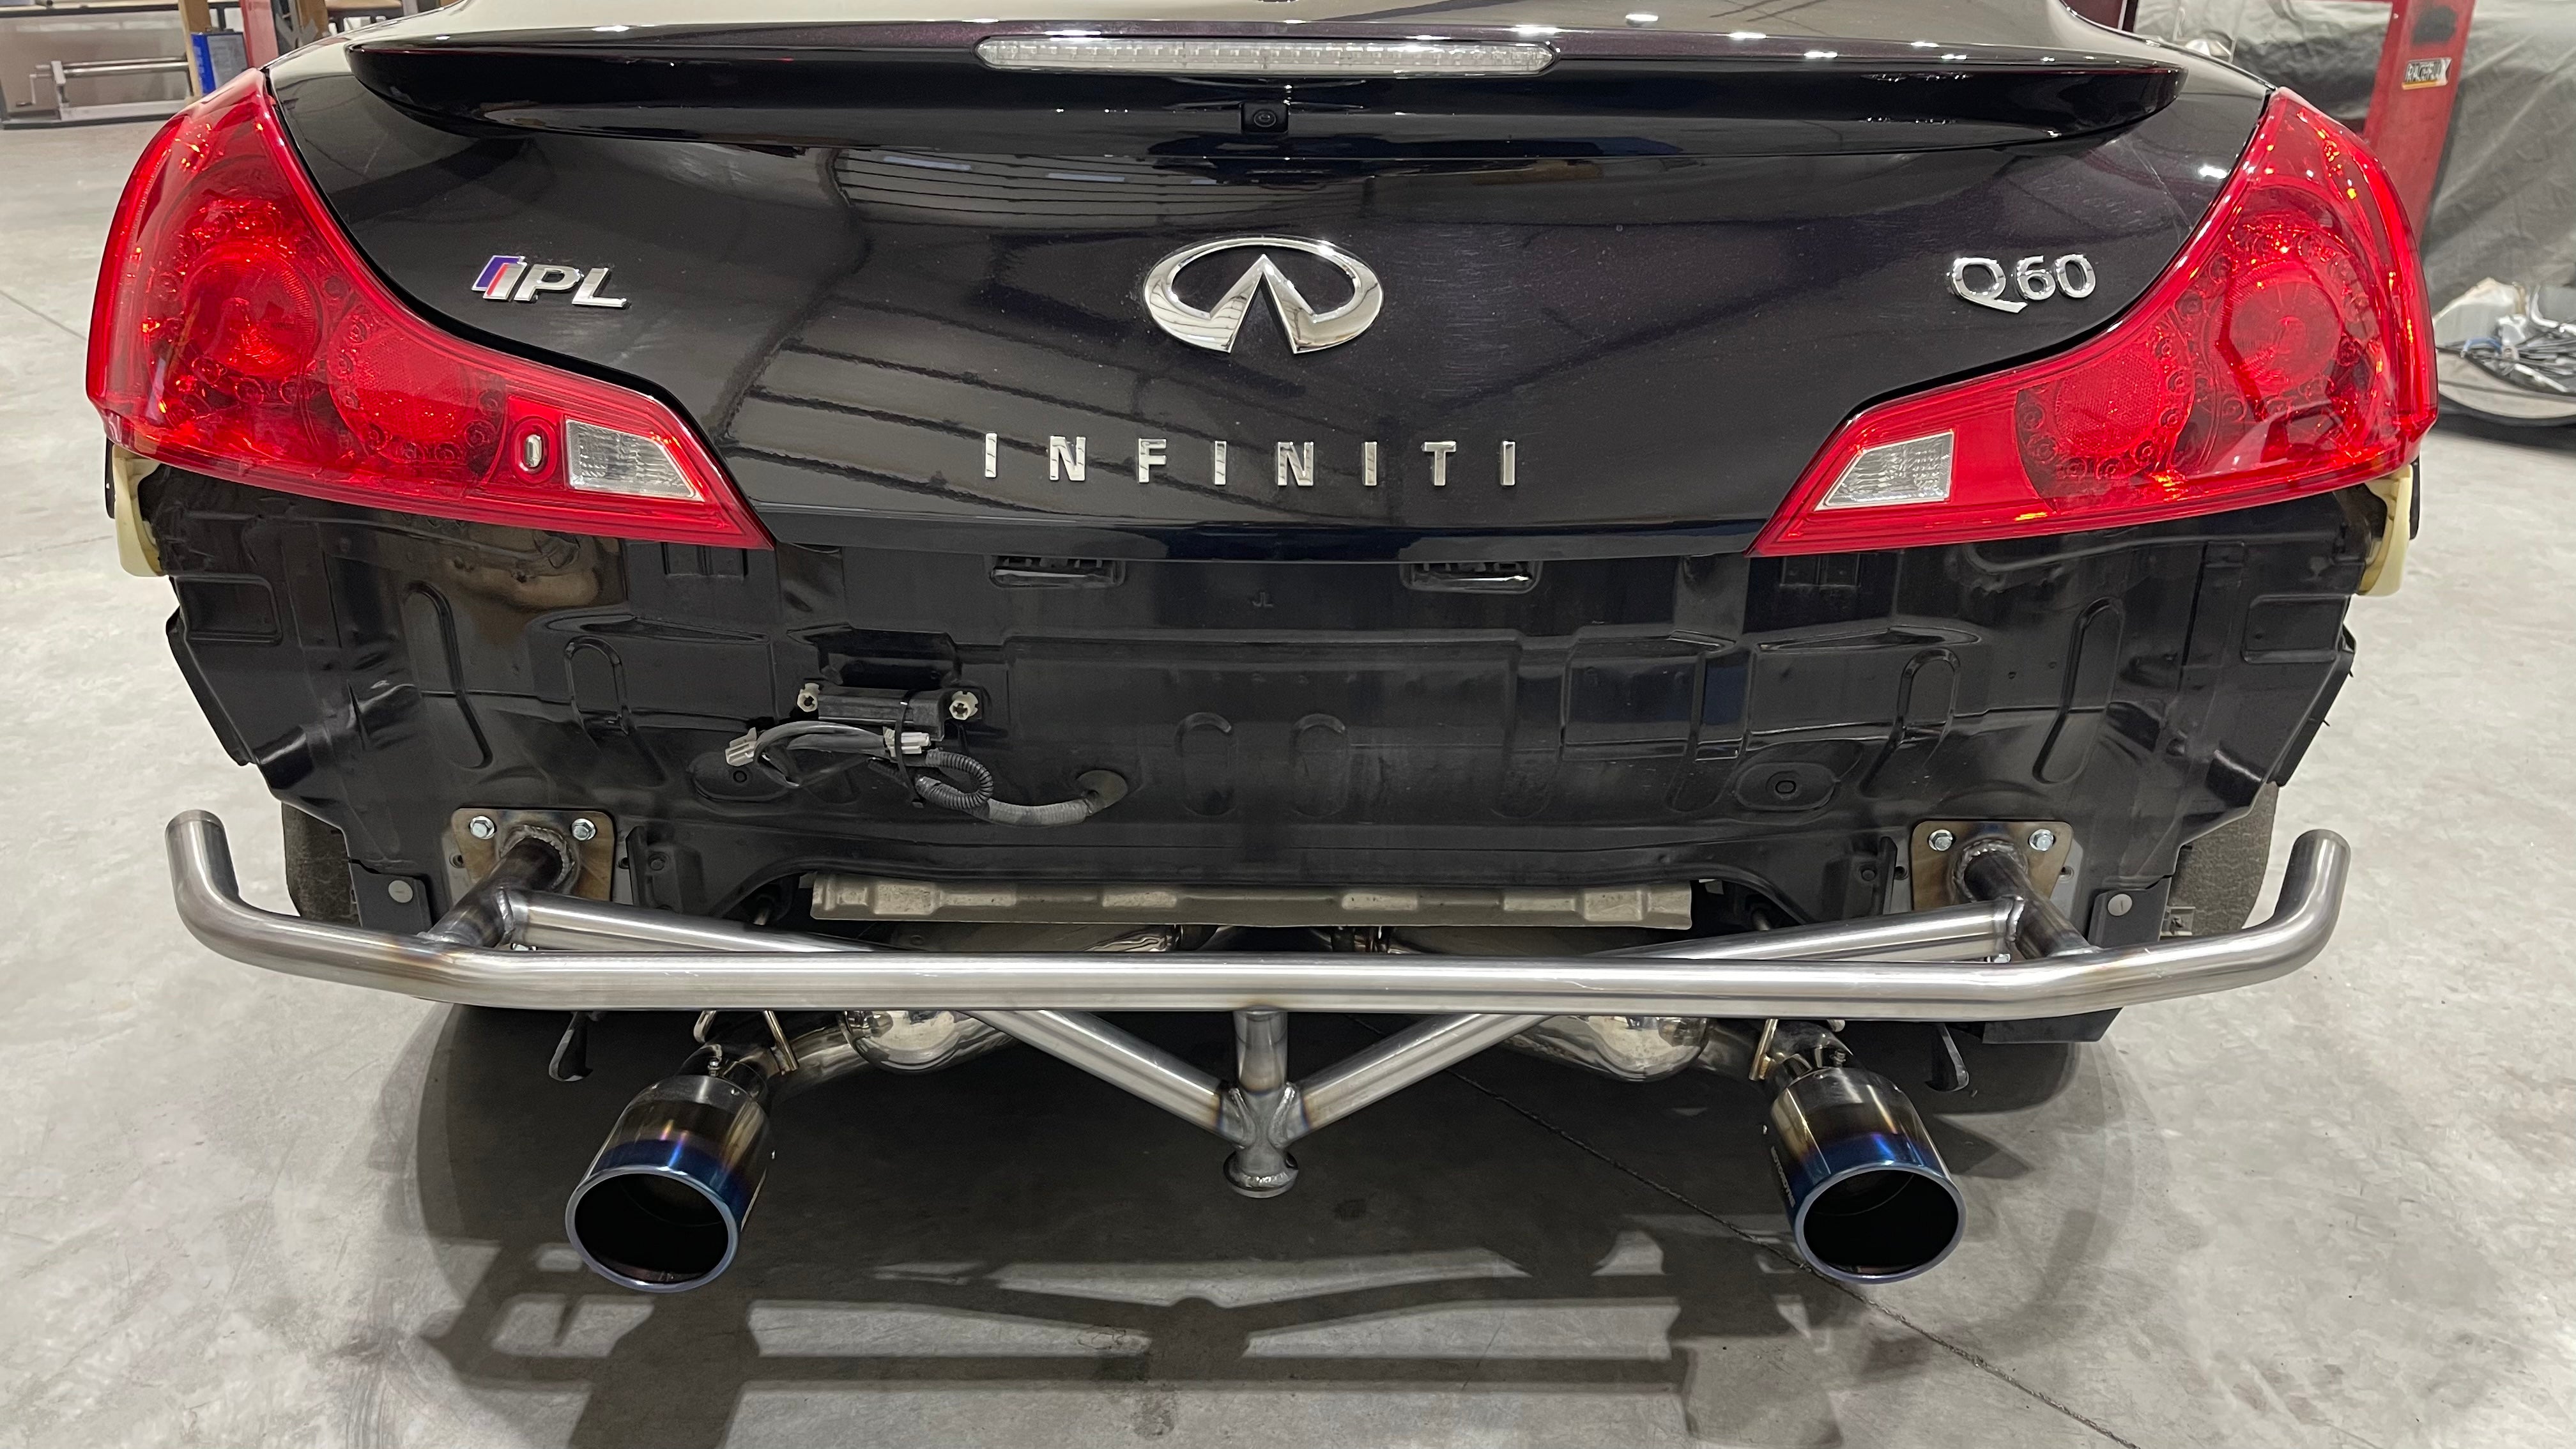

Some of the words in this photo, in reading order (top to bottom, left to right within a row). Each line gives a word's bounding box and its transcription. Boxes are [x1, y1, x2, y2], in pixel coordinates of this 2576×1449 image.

[471, 255, 627, 308] IPL
[1951, 254, 2097, 314] Q60
[984, 432, 1517, 487] INFINITI
